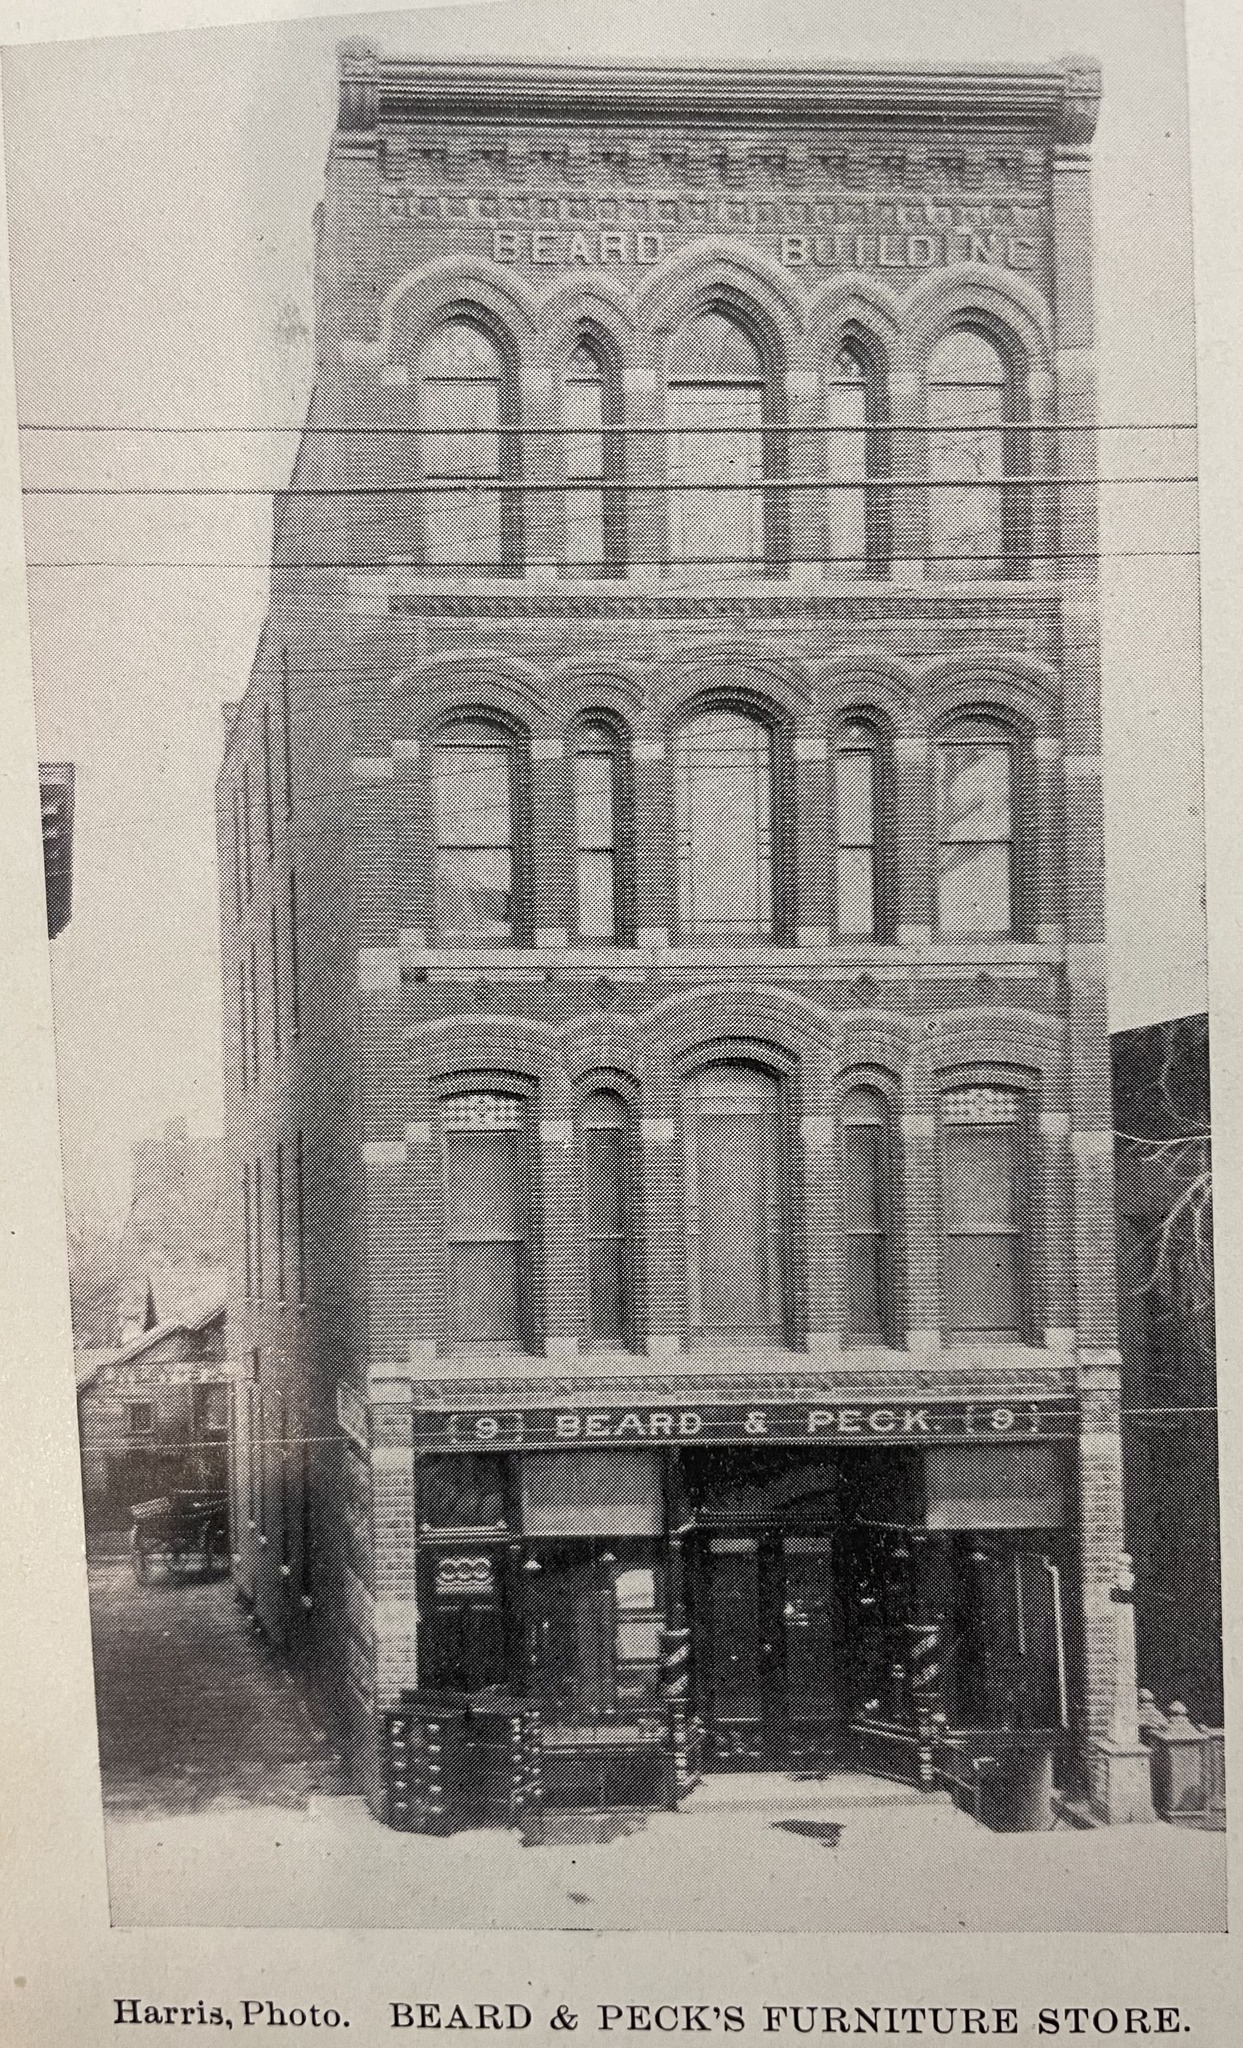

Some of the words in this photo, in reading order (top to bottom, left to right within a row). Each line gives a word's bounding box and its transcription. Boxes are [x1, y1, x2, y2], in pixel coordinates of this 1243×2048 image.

[493, 231, 663, 263] BEARD
[555, 1413, 702, 1438] BEARD
[743, 1412, 768, 1434] &
[113, 1999, 234, 2030] Harris,
[241, 2000, 351, 2028] Photo.
[389, 2002, 533, 2030] BEARD
[549, 2004, 579, 2031] &
[598, 2004, 744, 2032] PECK'S
[763, 2006, 1018, 2034] FURNITURE
[1038, 2007, 1191, 2034] STORE.
